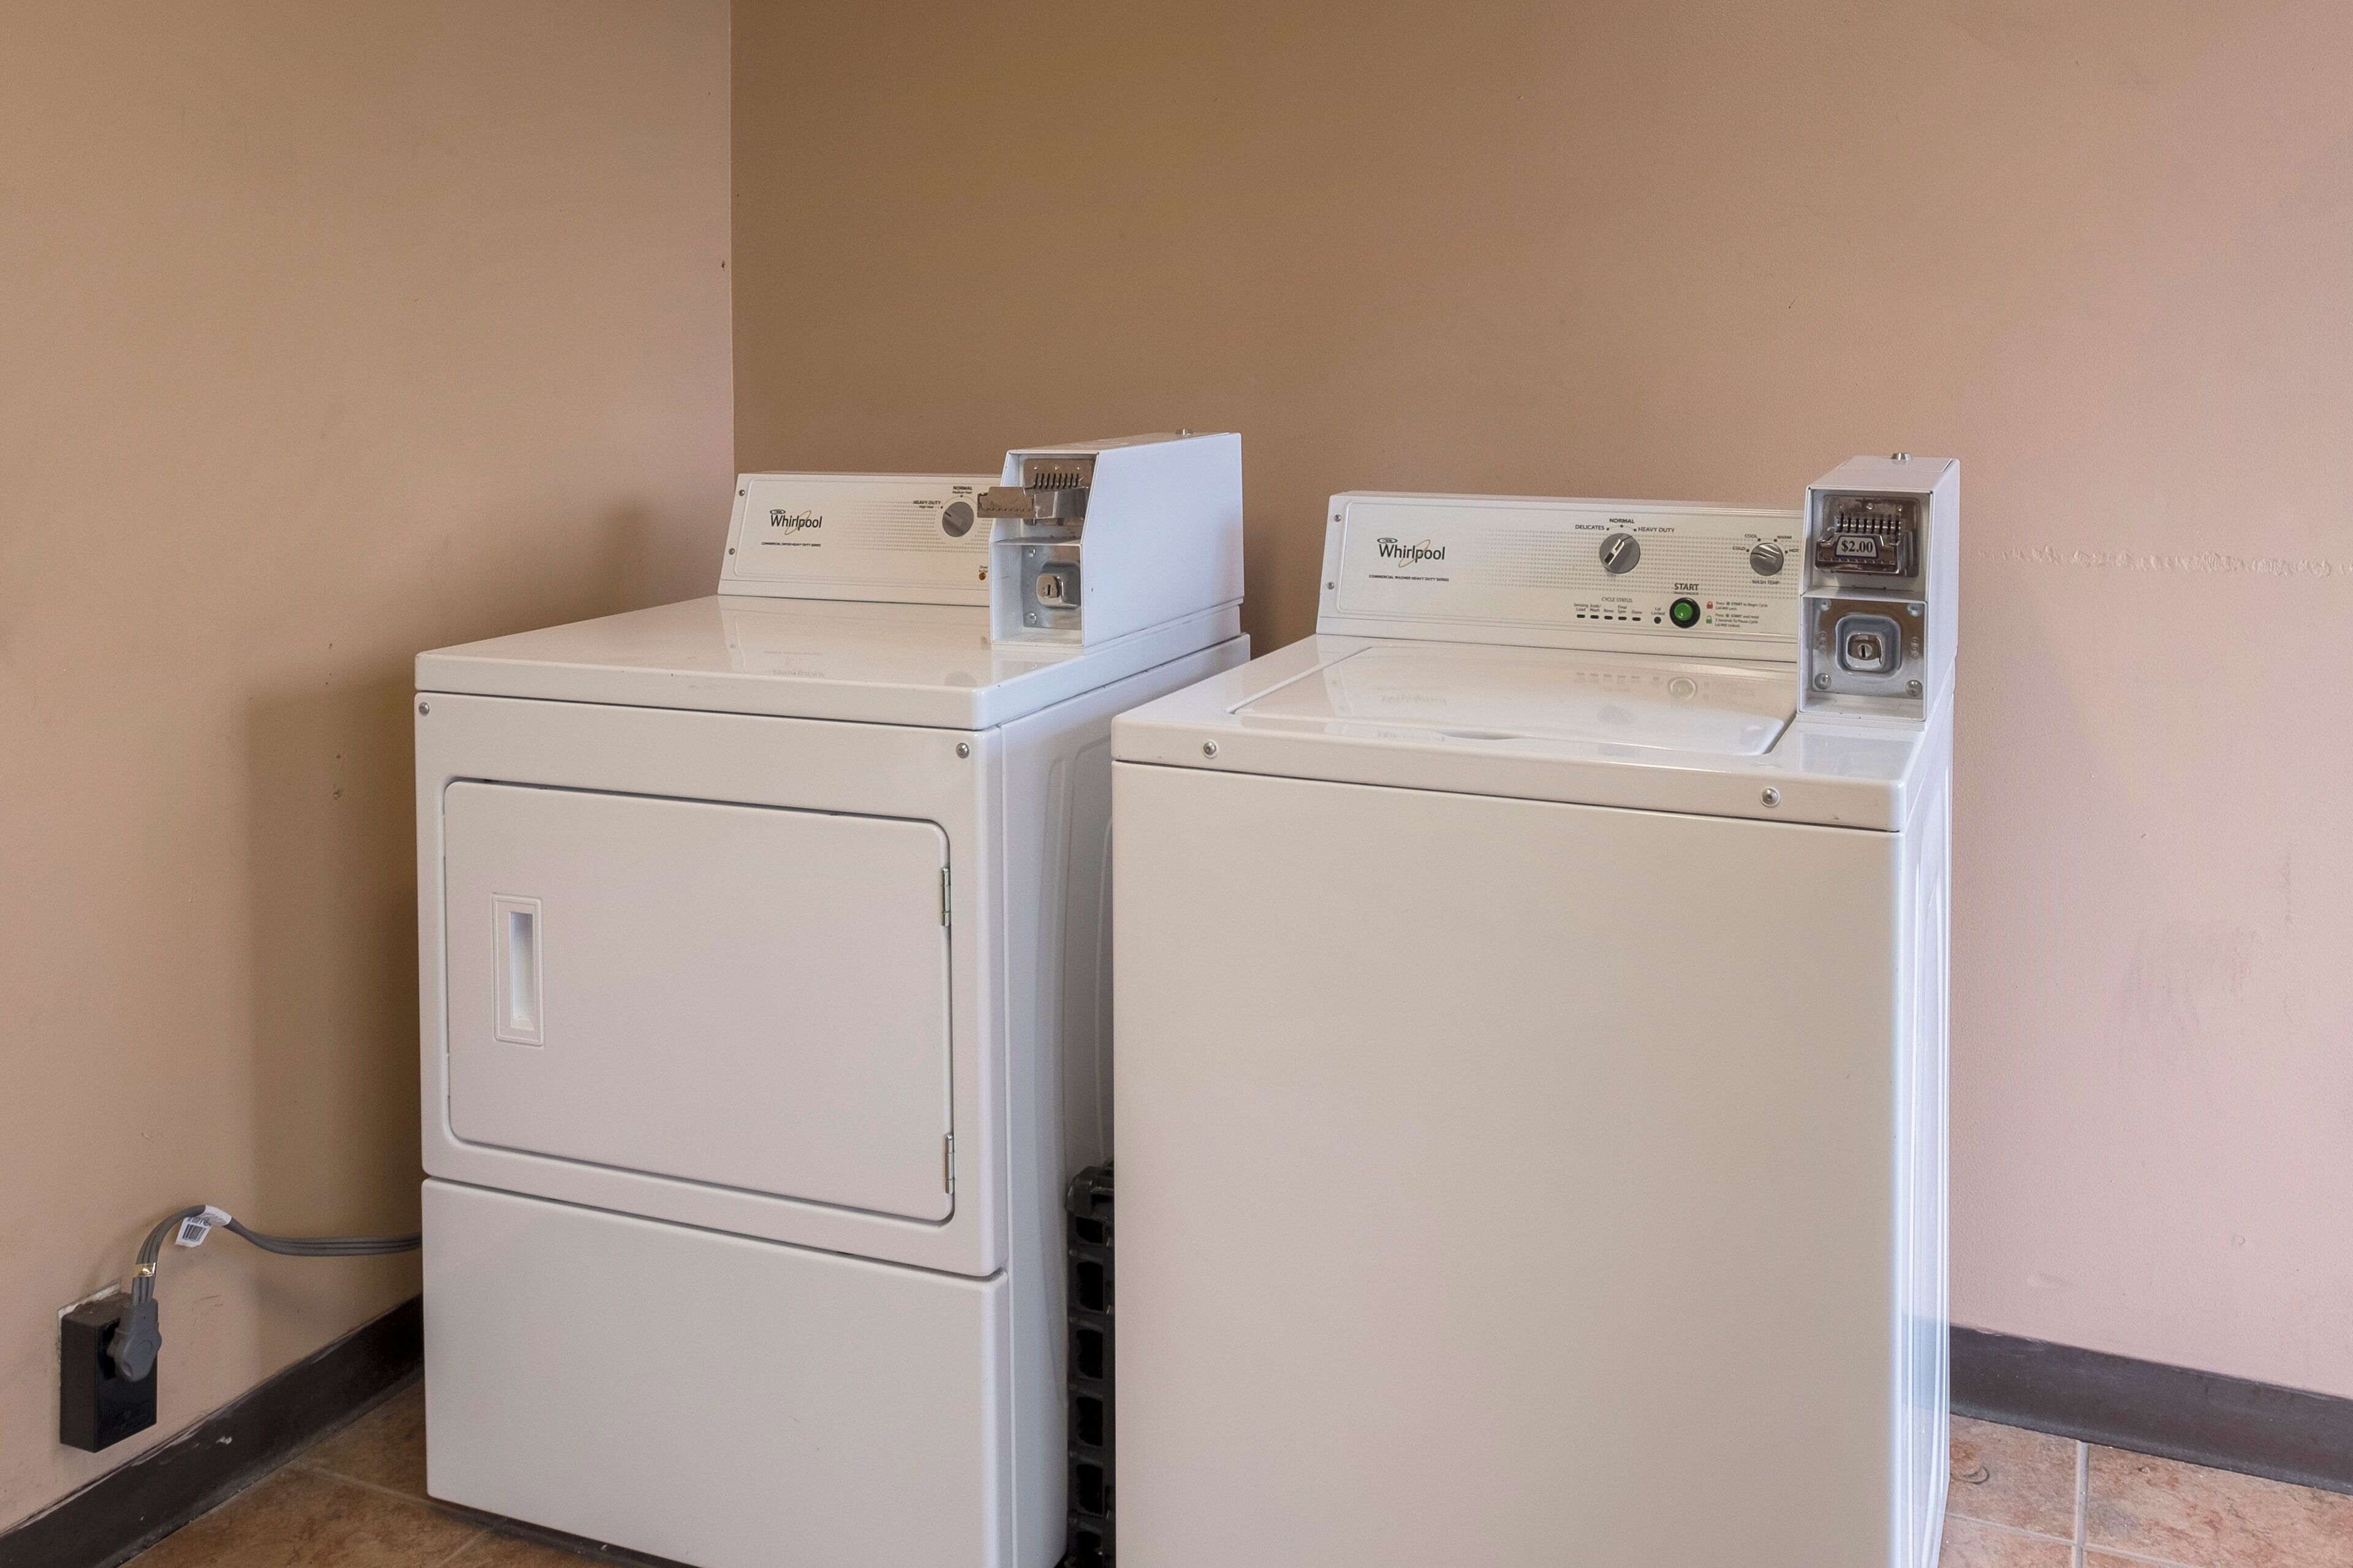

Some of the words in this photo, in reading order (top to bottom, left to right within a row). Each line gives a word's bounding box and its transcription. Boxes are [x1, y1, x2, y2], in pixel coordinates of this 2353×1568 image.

[771, 515, 822, 531] Whirlpool
[1379, 543, 1446, 563] Whirlpool
[1841, 540, 1873, 553] $2.00
